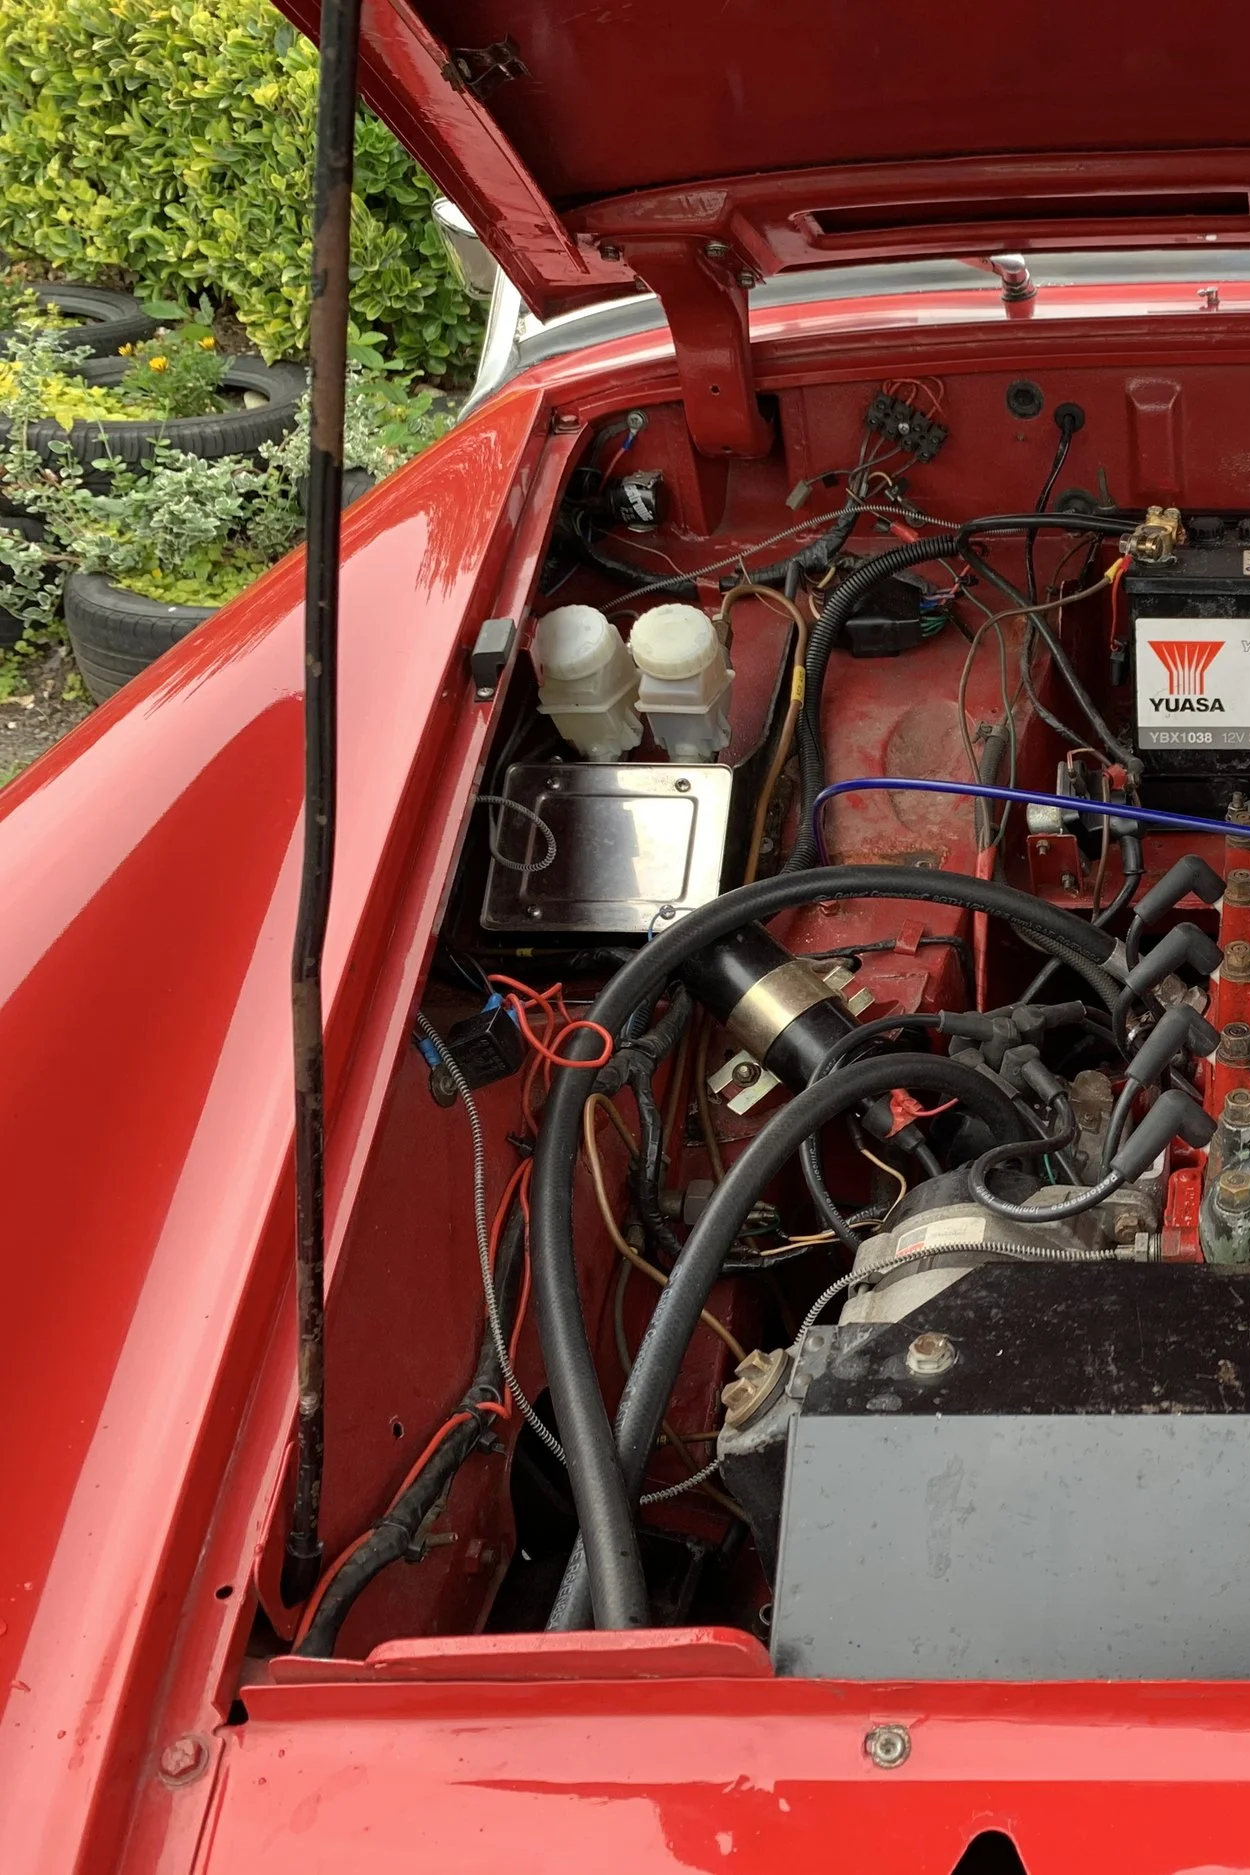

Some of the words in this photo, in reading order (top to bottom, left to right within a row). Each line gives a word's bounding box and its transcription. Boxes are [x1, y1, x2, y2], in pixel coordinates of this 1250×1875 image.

[1149, 698, 1225, 712] YUASA
[1150, 732, 1213, 743] YBX1038
[1222, 732, 1245, 743] 12V
[1051, 1173, 1119, 1212] Performance
